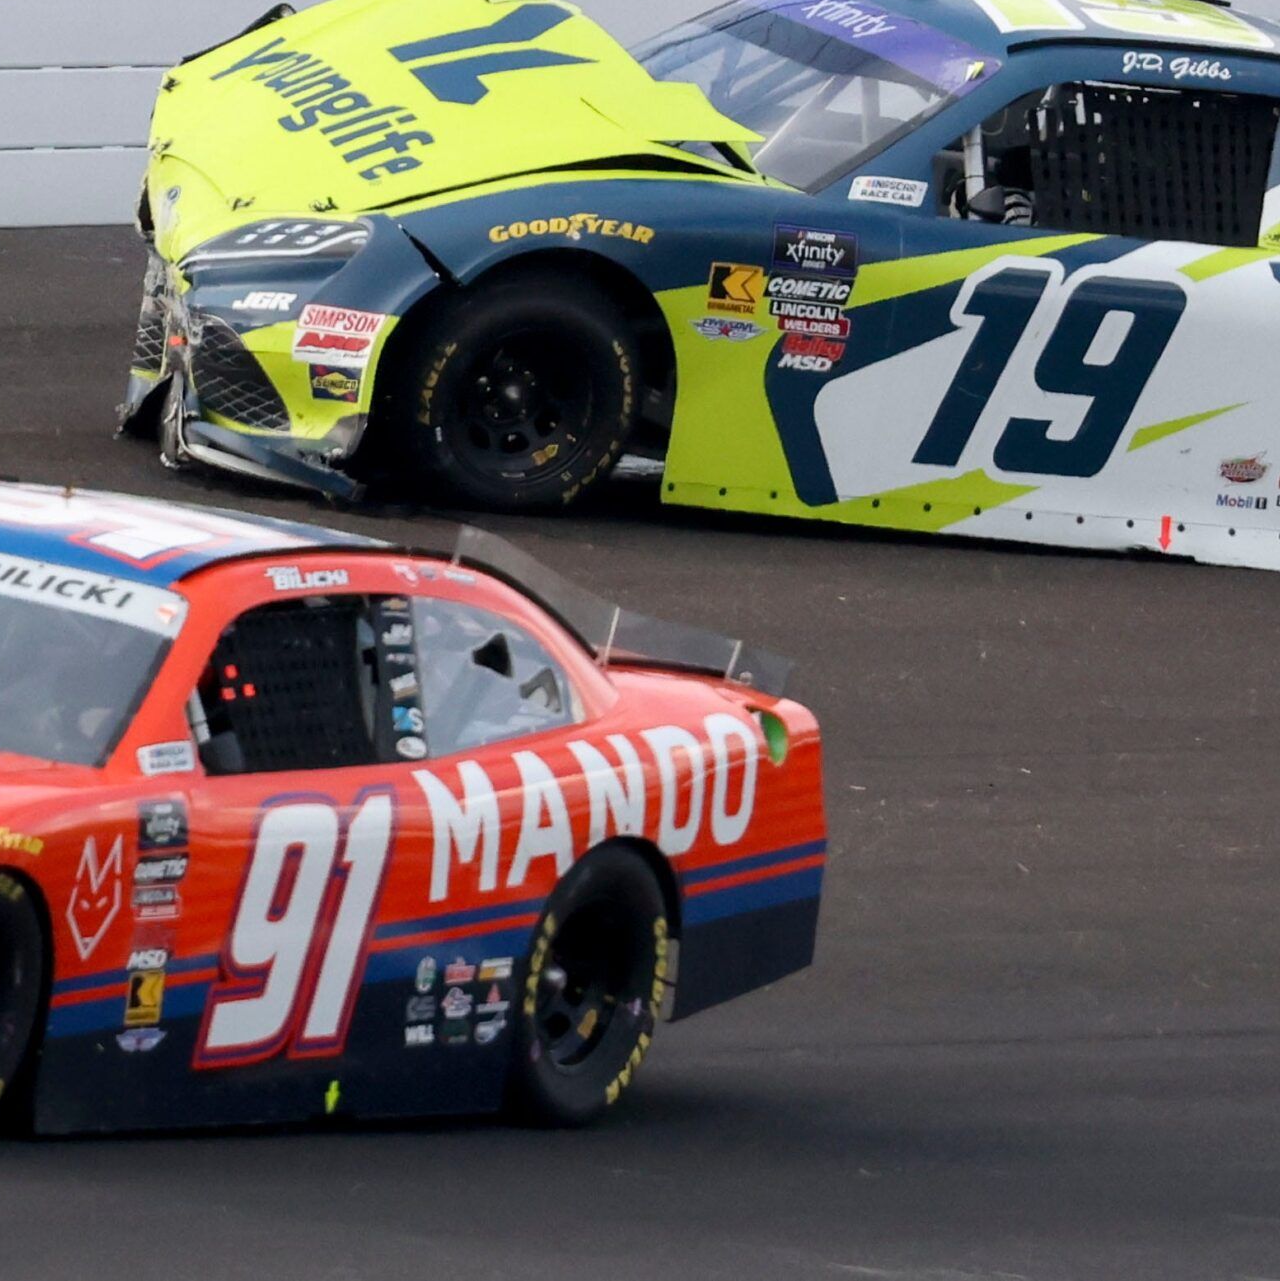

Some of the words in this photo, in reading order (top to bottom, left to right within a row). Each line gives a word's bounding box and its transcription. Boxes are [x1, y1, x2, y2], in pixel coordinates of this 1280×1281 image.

[1170, 56, 1232, 81] Gibbs
[209, 36, 436, 182] younglife
[860, 188, 889, 199] RACE
[488, 213, 655, 244] GOODYEAR
[786, 239, 846, 266] xfinity
[232, 291, 297, 311] JGR
[769, 278, 851, 300] COMETIC
[304, 308, 380, 333] SIMPSON
[772, 301, 837, 320] LINCOLN
[784, 319, 841, 334] WELDERS
[777, 352, 833, 371] MSD
[912, 268, 1188, 478] 19
[1216, 493, 1253, 509] Mobil
[411, 714, 758, 903] MANDO
[205, 794, 393, 1049] 91
